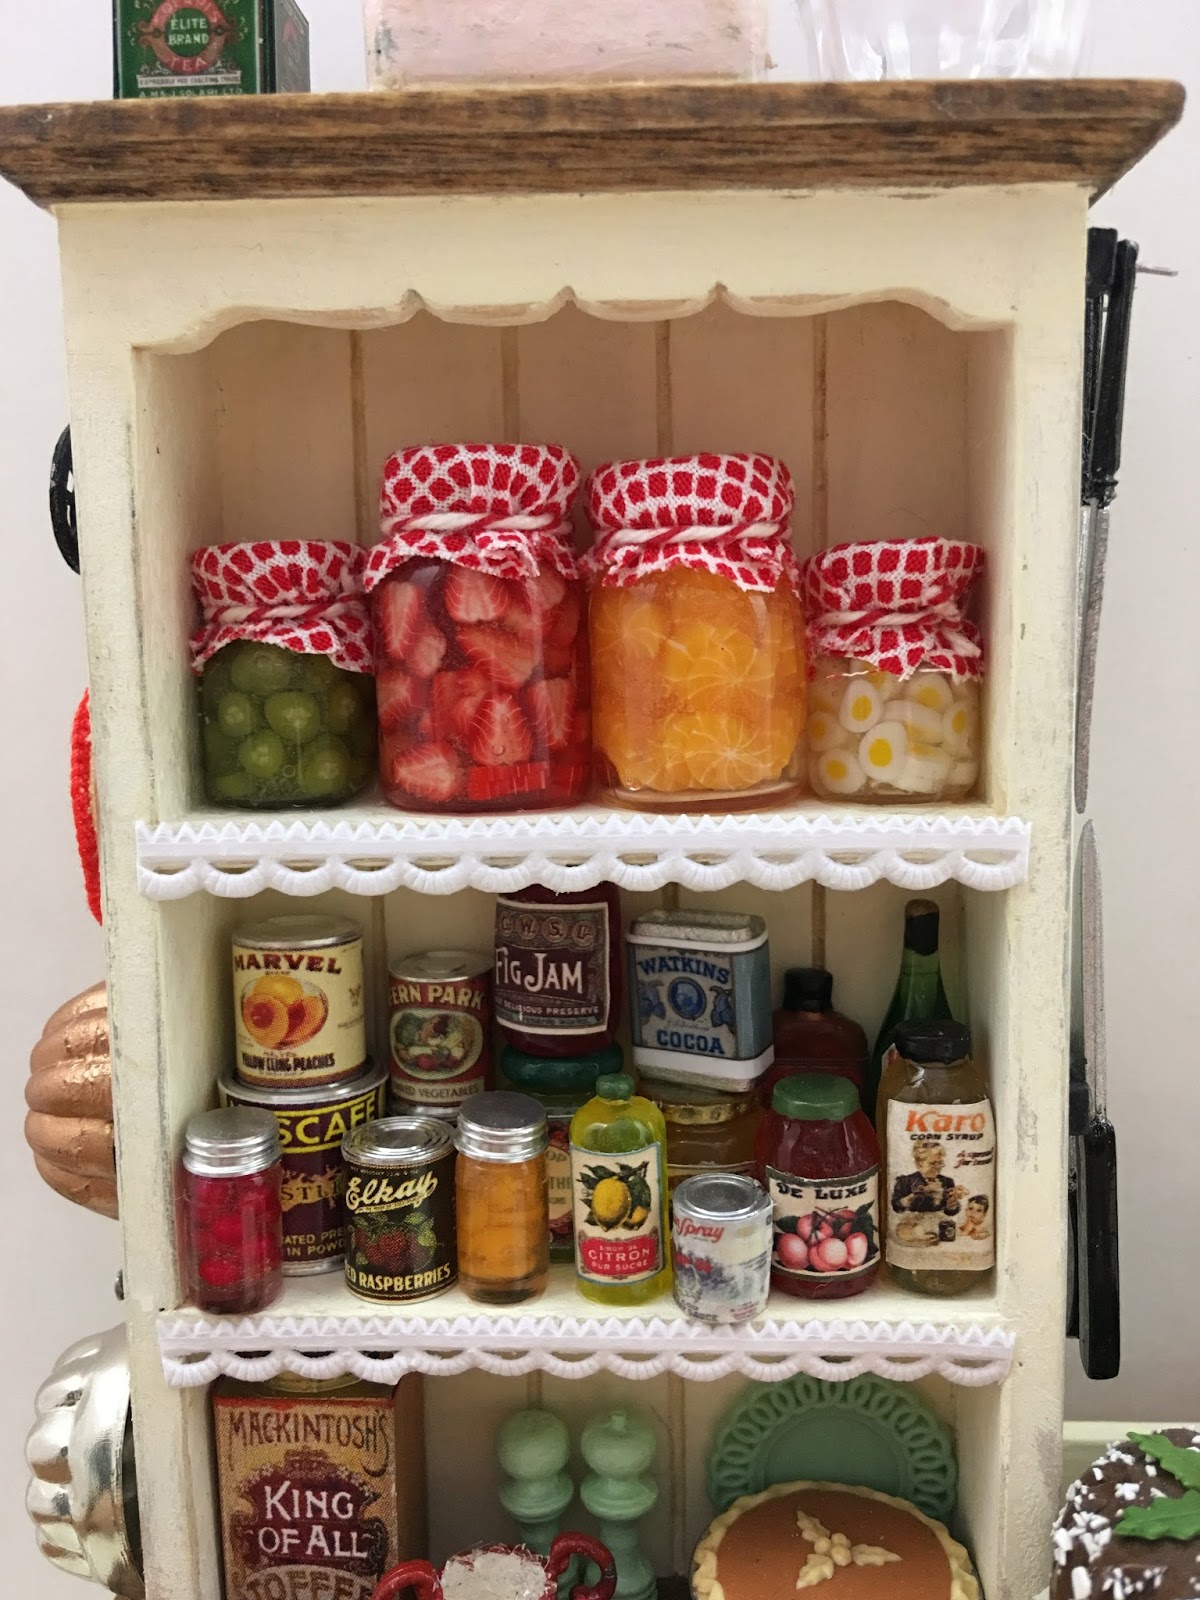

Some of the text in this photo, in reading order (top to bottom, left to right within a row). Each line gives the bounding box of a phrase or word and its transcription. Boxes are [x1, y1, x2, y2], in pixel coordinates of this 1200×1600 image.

[170, 14, 208, 30] ELITE
[168, 33, 210, 46] BRAND
[170, 56, 208, 72] TEA
[234, 953, 342, 975] MARVEL
[524, 952, 583, 994] JAM
[638, 955, 730, 985] WATKINS
[389, 984, 422, 1006] ERN
[428, 984, 485, 1011] PARK
[656, 1029, 725, 1055] COCOA
[292, 1052, 335, 1072] PEACHES
[418, 1083, 480, 1099] VEGETABLES
[278, 1099, 376, 1146] SCAFE
[905, 1109, 987, 1133] Karo
[909, 1132, 984, 1141] CORN SYRUP
[345, 1170, 439, 1211] Elkay
[775, 1181, 869, 1200] DE LUXE
[286, 1247, 302, 1257] IN
[588, 1246, 651, 1262] CITRON
[591, 1258, 649, 1271] PUR SUCRE
[346, 1262, 451, 1292] ED RASPBERRIES
[263, 1479, 354, 1522] KING
[257, 1524, 368, 1558] OF ALL
